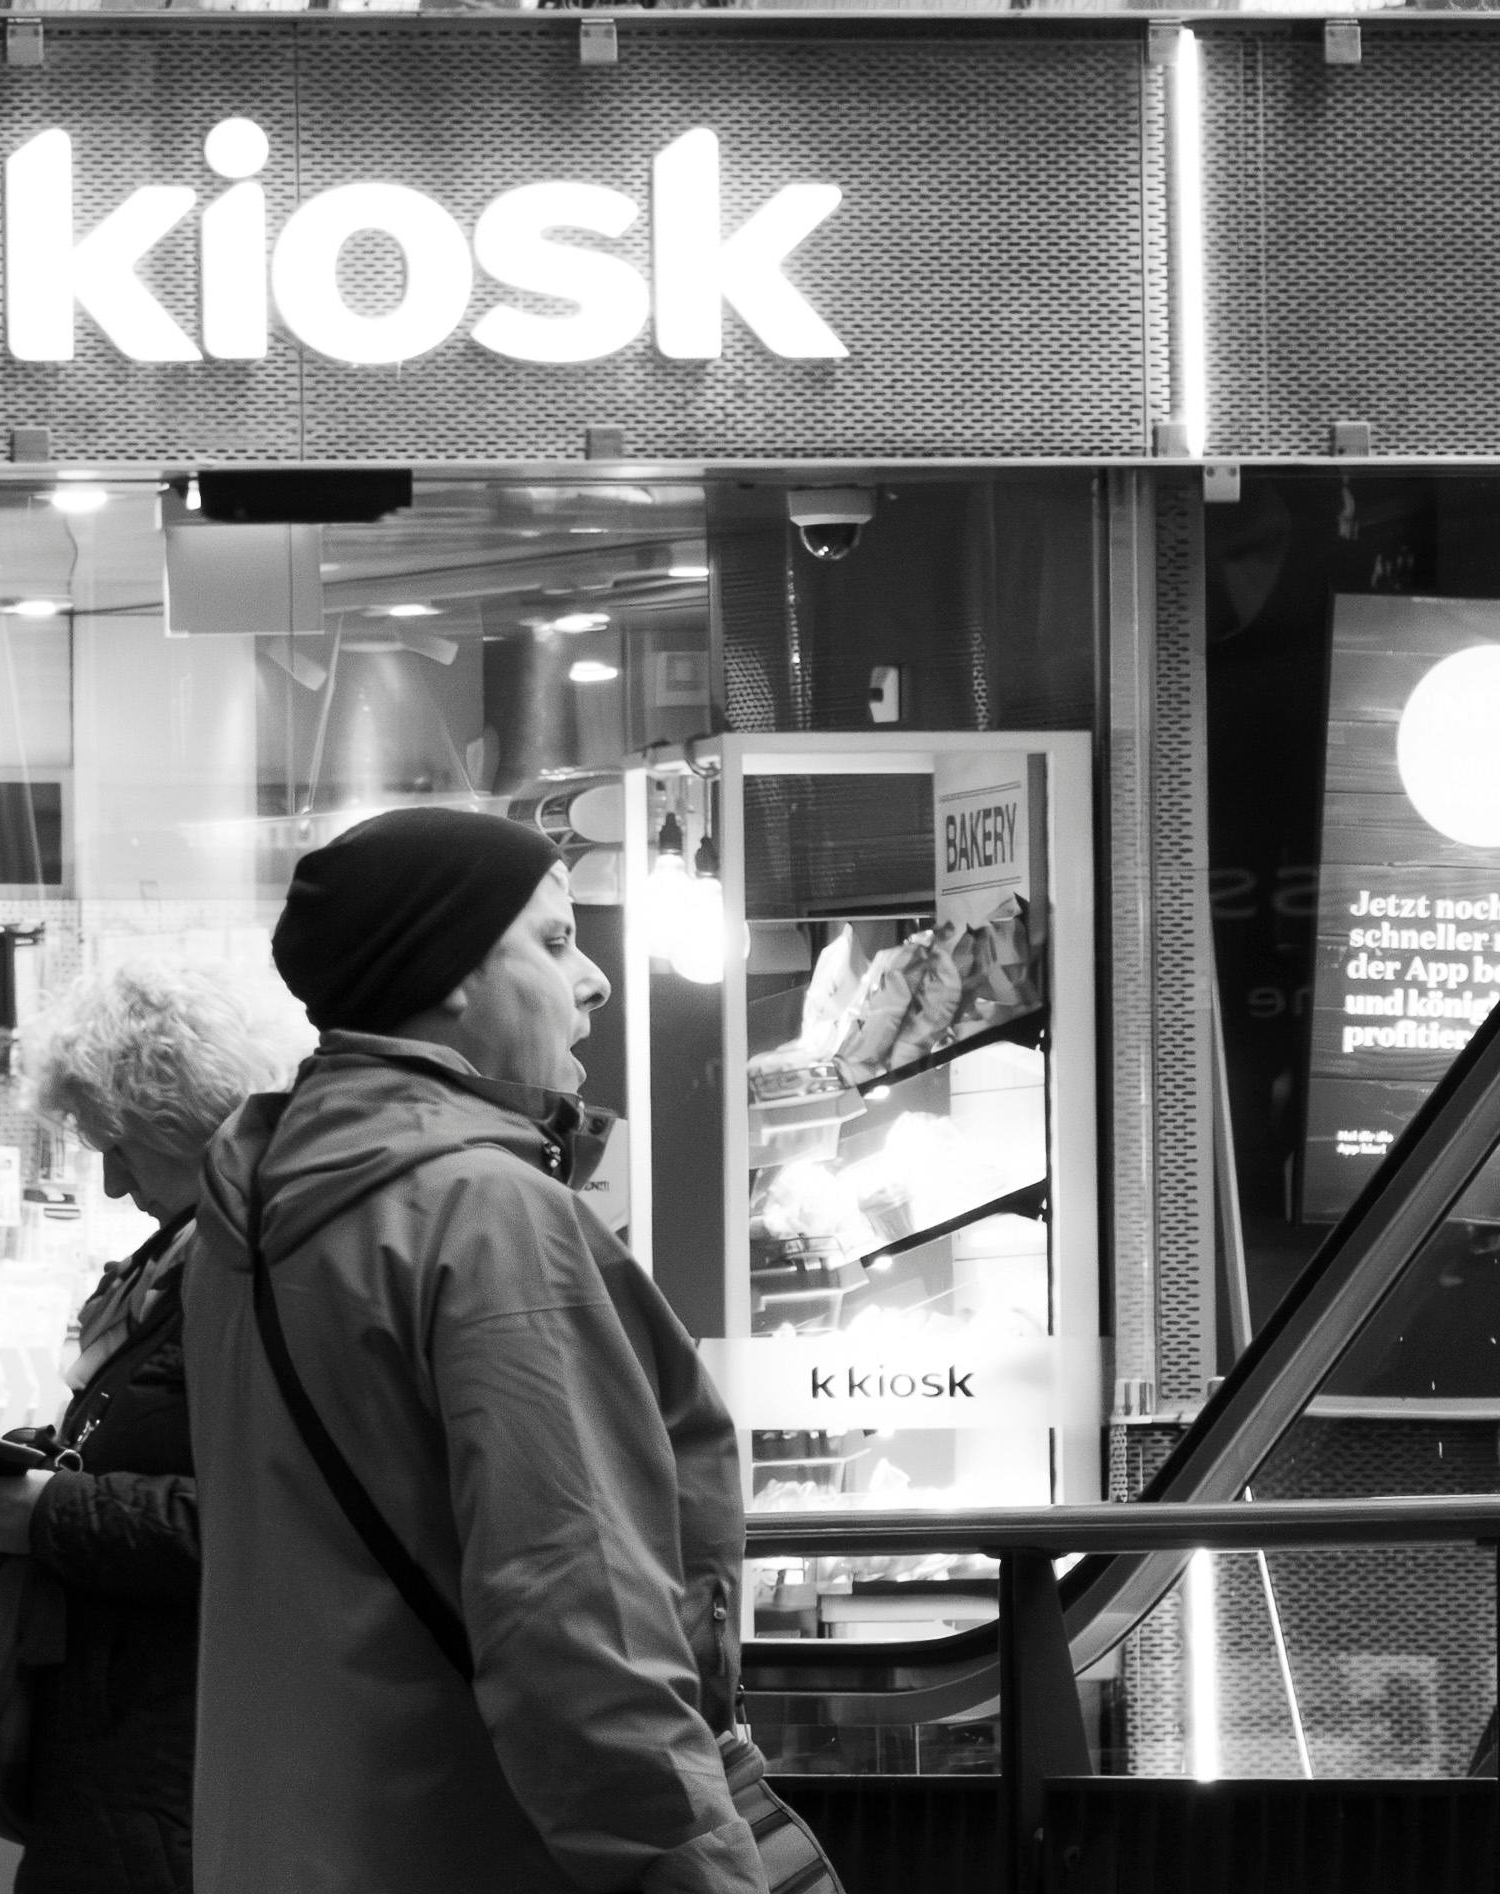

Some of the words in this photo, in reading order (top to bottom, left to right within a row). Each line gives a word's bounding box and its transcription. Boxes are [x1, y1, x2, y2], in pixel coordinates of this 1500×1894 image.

[4, 117, 850, 364] kiosk
[946, 802, 1018, 874] BAKERY
[1350, 890, 1431, 918] Jetzt
[1349, 922, 1489, 950] schneller
[1346, 953, 1401, 980] der
[1404, 956, 1469, 989] App
[1344, 988, 1404, 1016] und
[811, 1366, 840, 1399] k
[849, 1364, 978, 1400] kiosk
